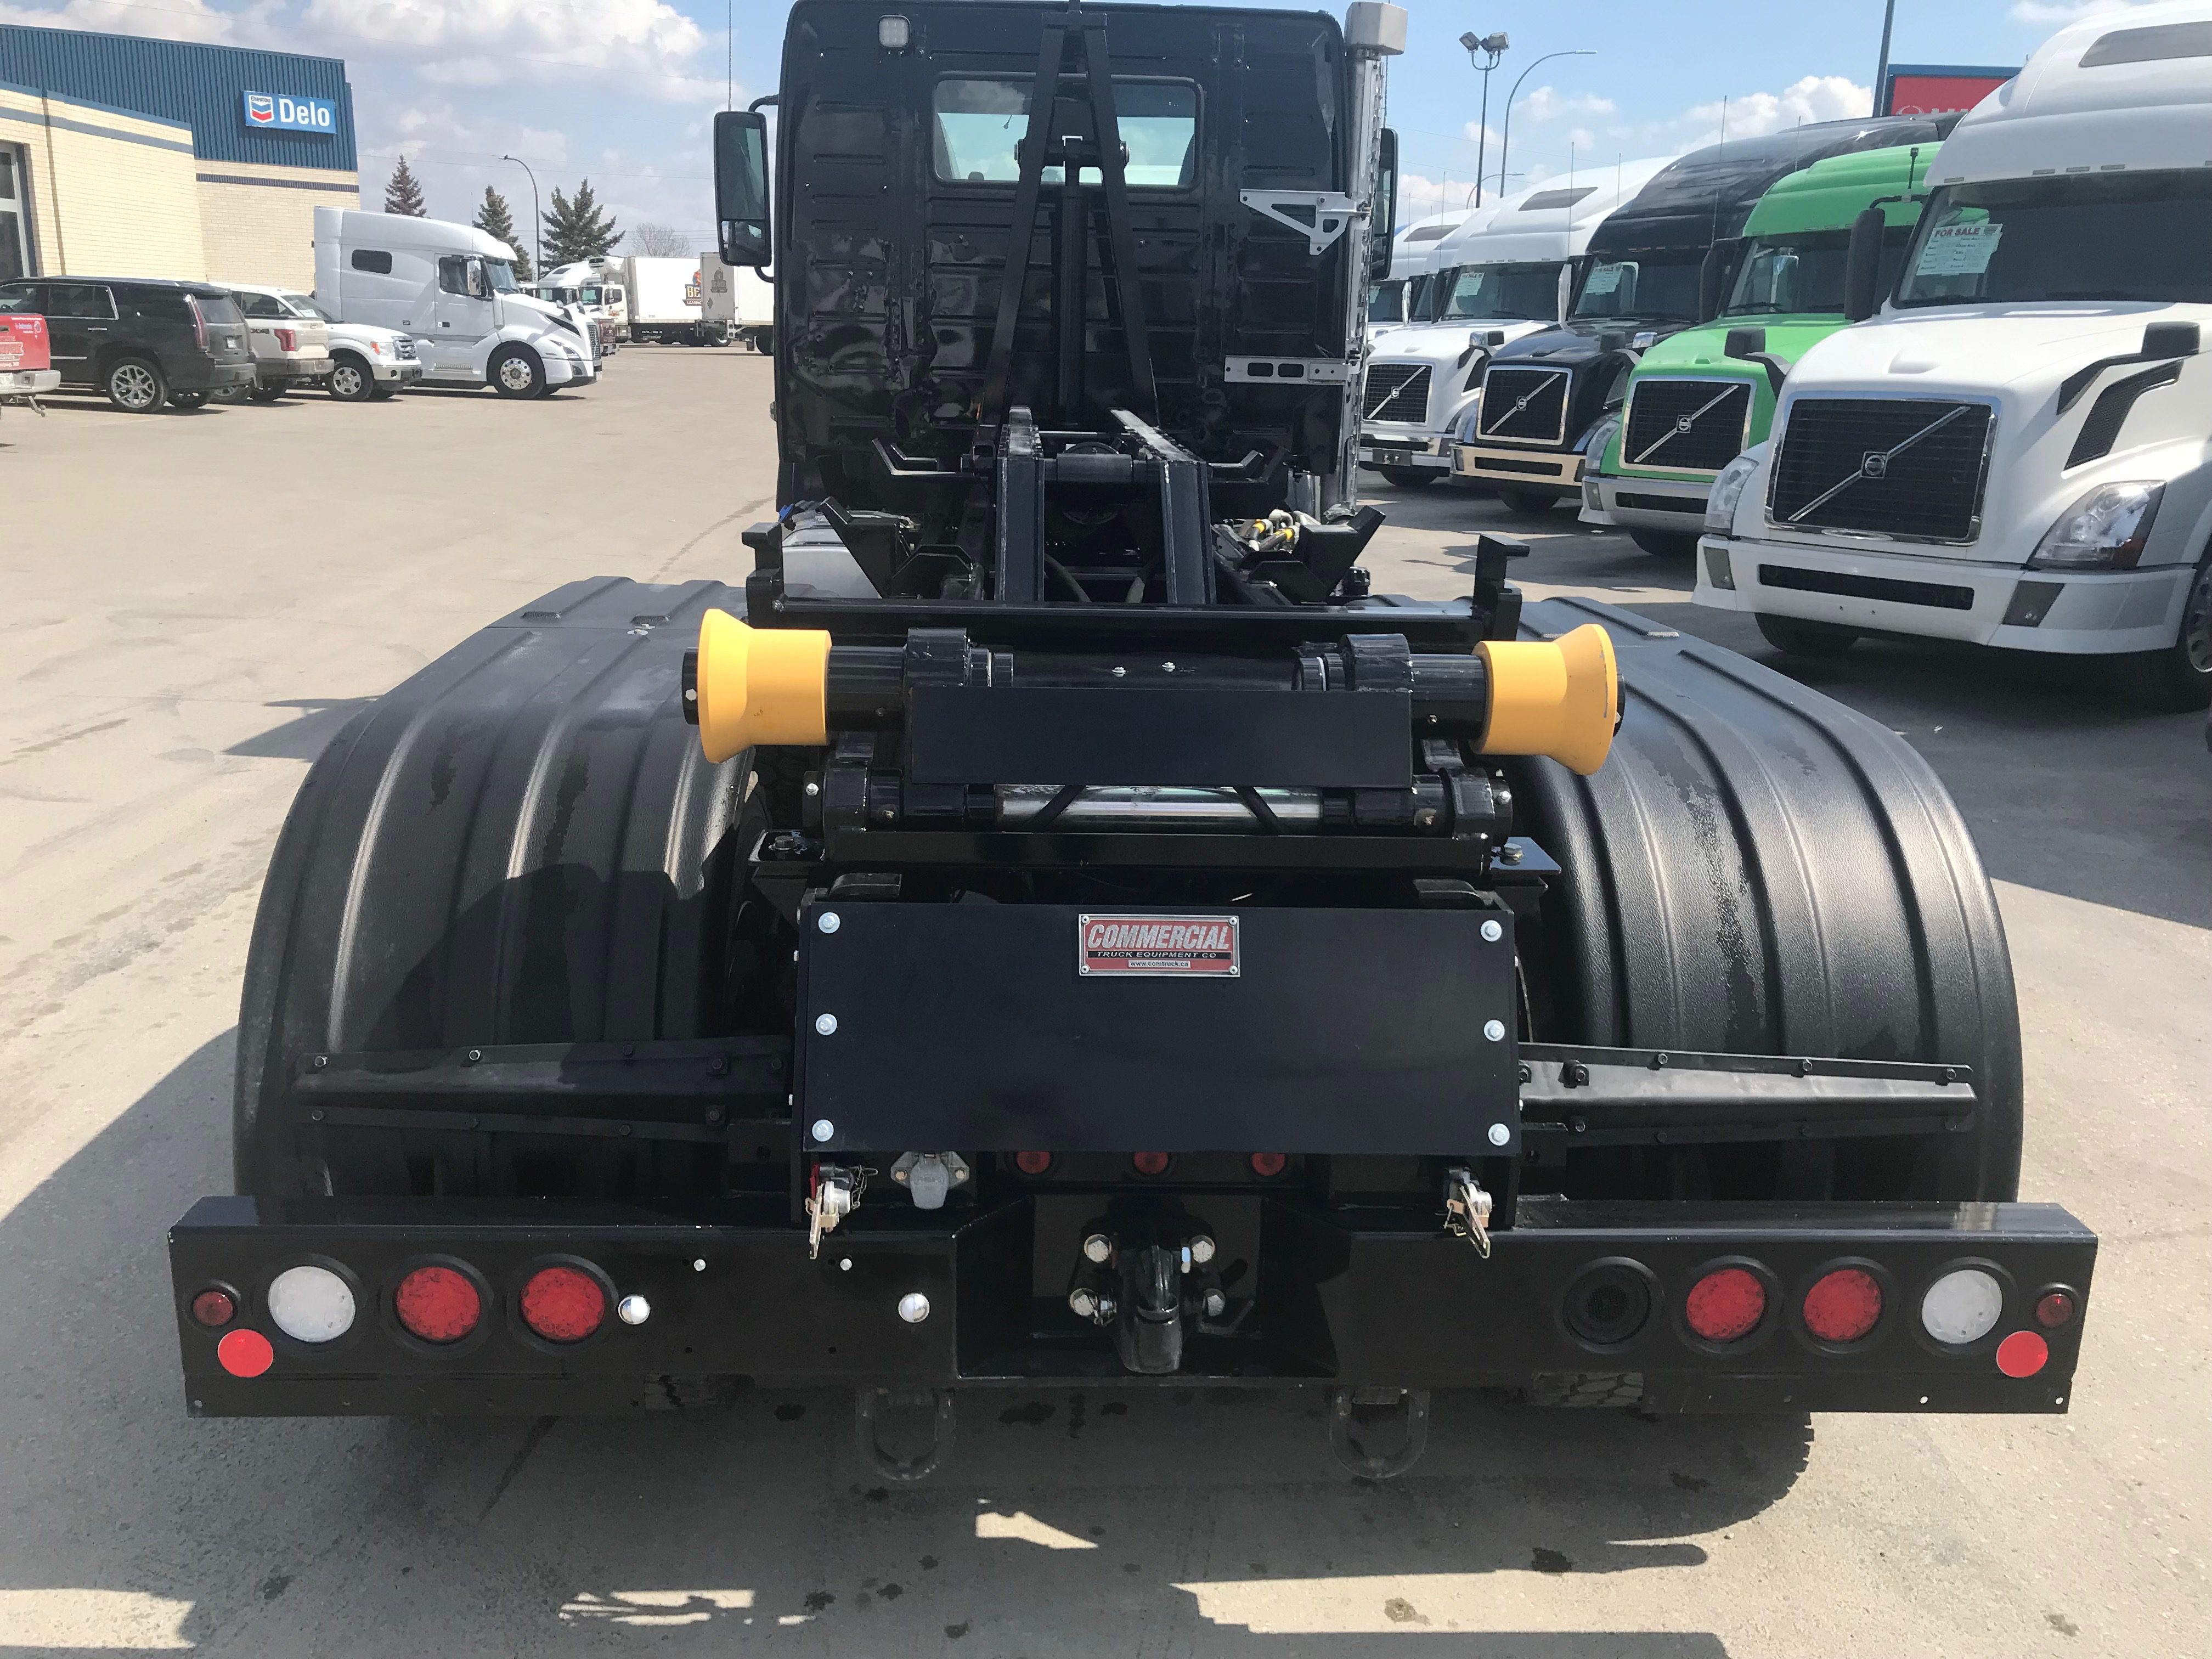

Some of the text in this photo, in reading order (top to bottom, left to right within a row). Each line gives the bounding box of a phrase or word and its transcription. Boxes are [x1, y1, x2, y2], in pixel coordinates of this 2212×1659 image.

[279, 98, 330, 127] Delo
[1934, 229, 1953, 238] FOR
[1954, 227, 1980, 235] SALE
[687, 286, 701, 297] BE
[1087, 924, 1229, 950] COMMERCIAL
